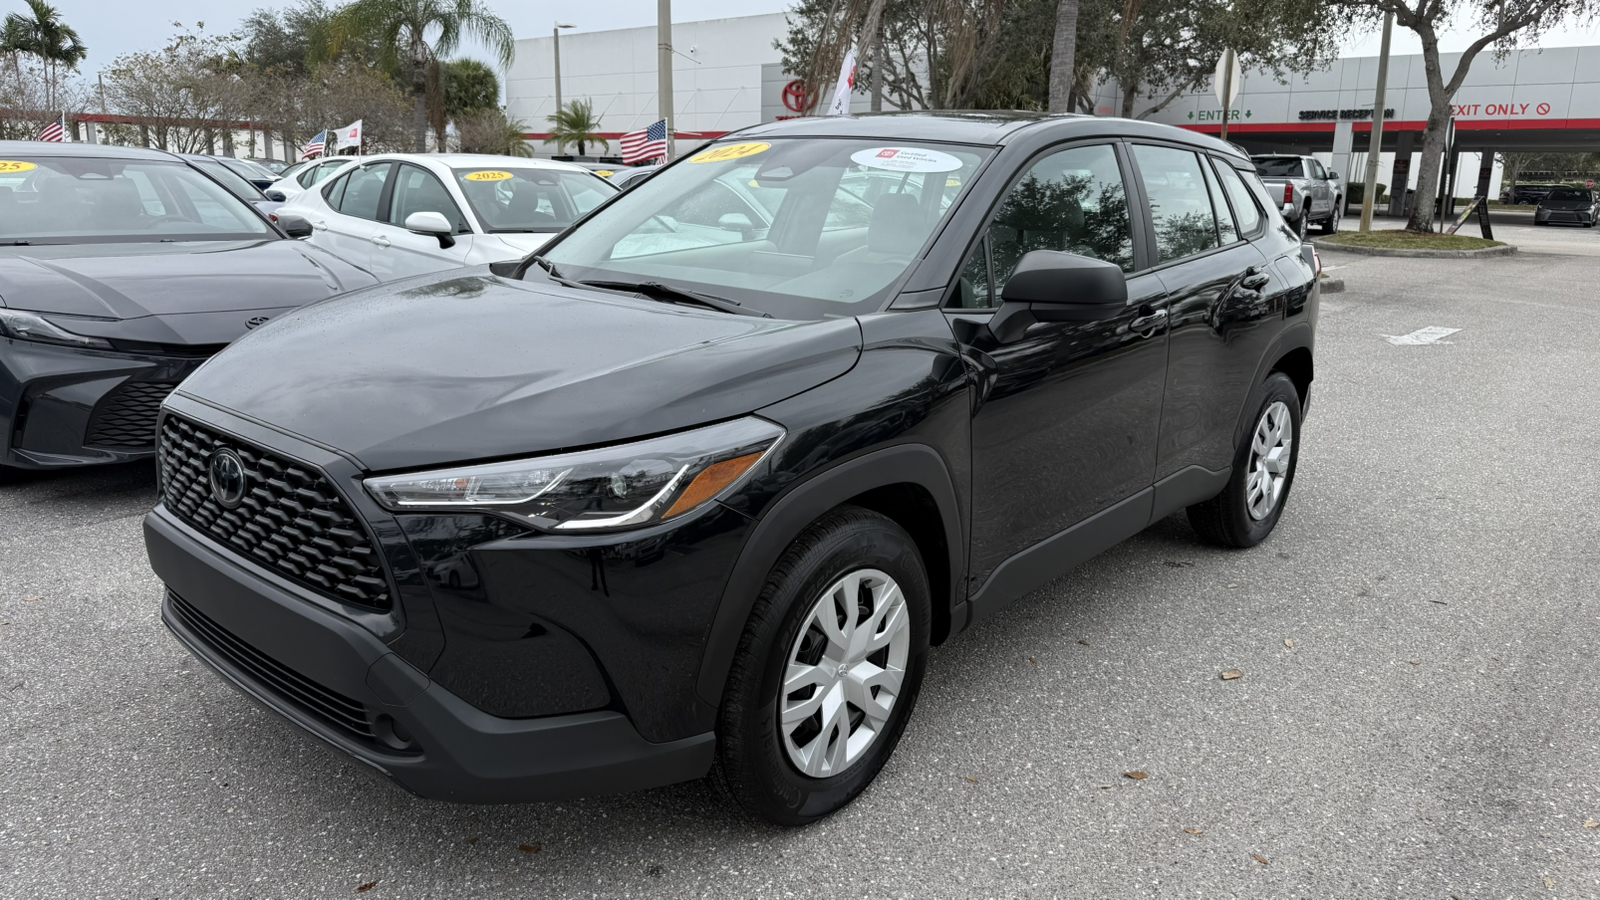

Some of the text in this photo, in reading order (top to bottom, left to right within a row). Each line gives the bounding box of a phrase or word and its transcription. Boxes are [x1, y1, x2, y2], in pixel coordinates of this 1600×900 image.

[1298, 108, 1395, 121] SERVICE RECEPTN
[1485, 103, 1530, 116] ONLY
[475, 172, 504, 180] 2025
